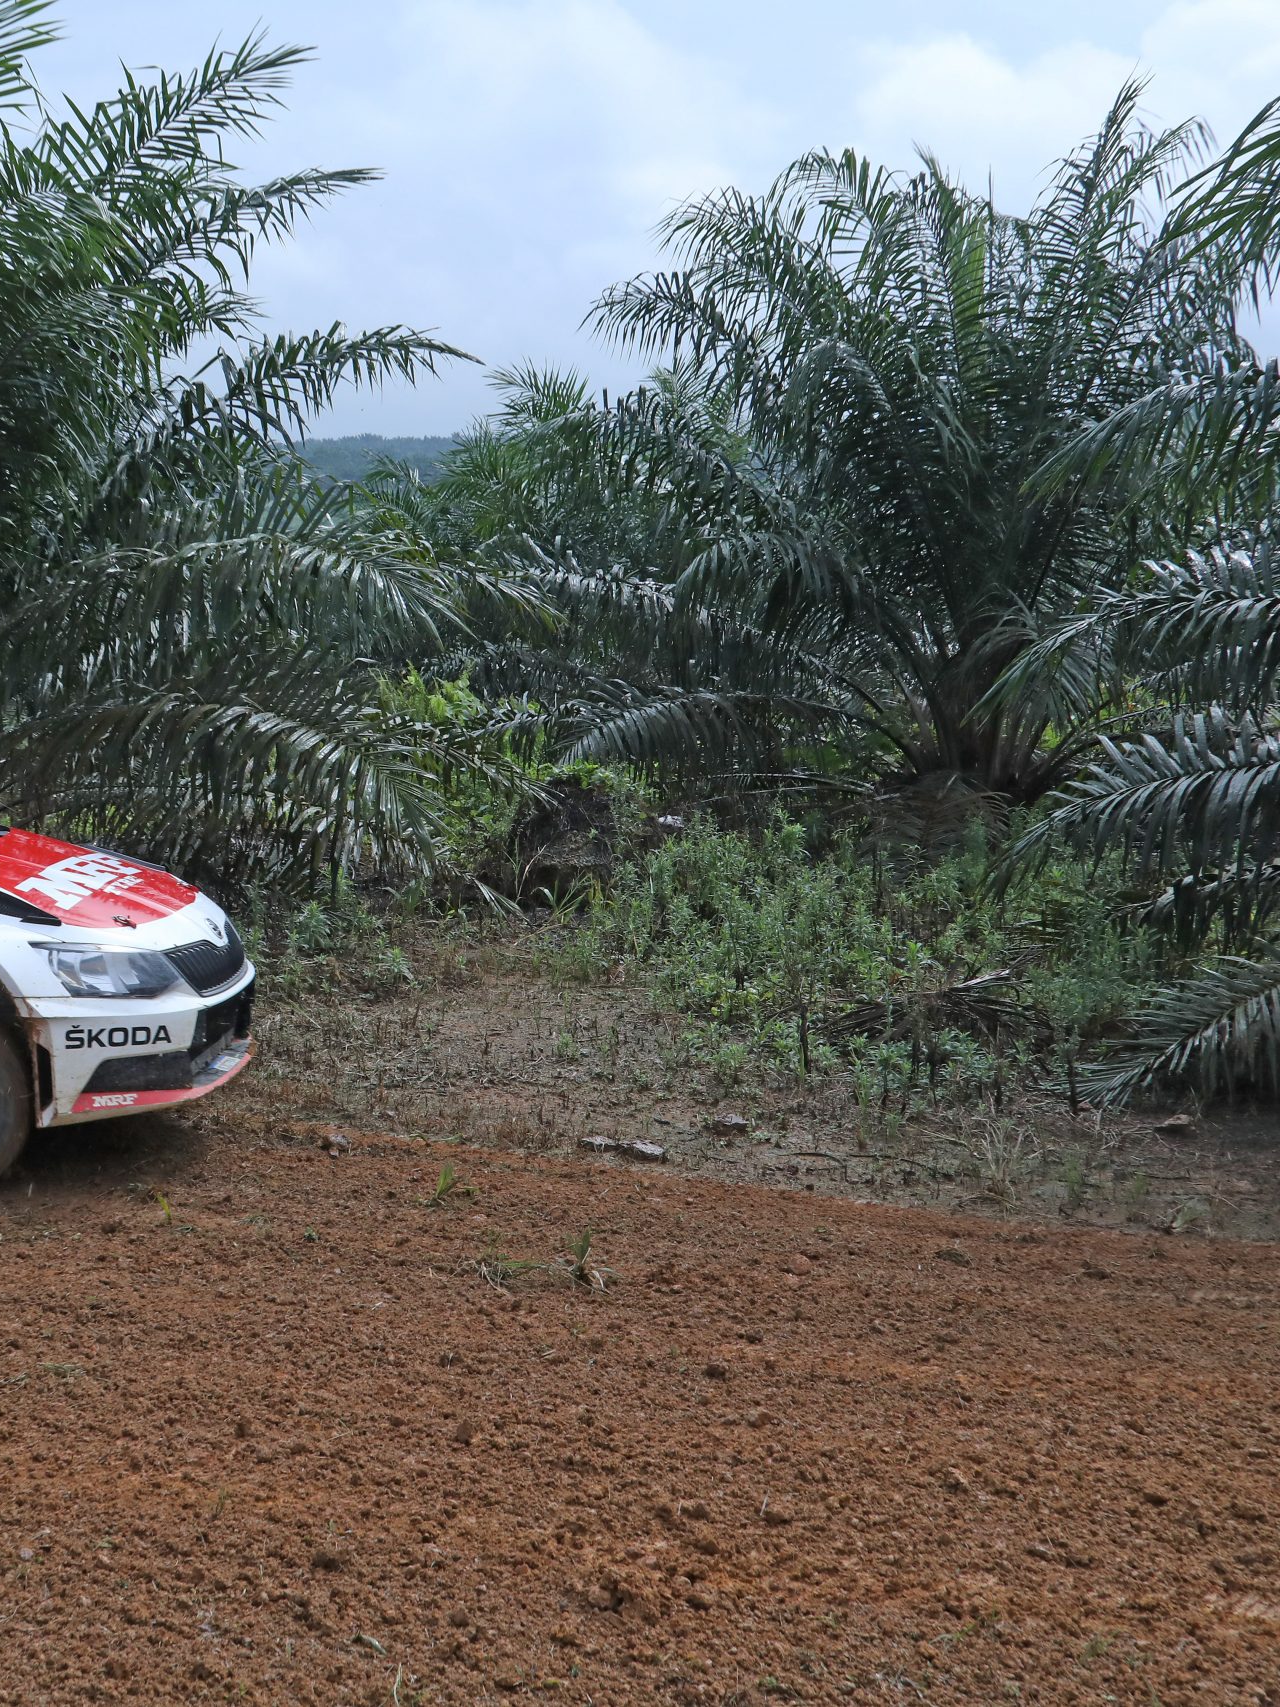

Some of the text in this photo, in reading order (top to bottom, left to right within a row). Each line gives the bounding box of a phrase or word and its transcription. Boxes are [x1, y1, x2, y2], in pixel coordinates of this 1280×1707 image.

[14, 852, 144, 910] MRF
[64, 1025, 173, 1050] ŠKODA
[92, 1093, 139, 1108] MRF
